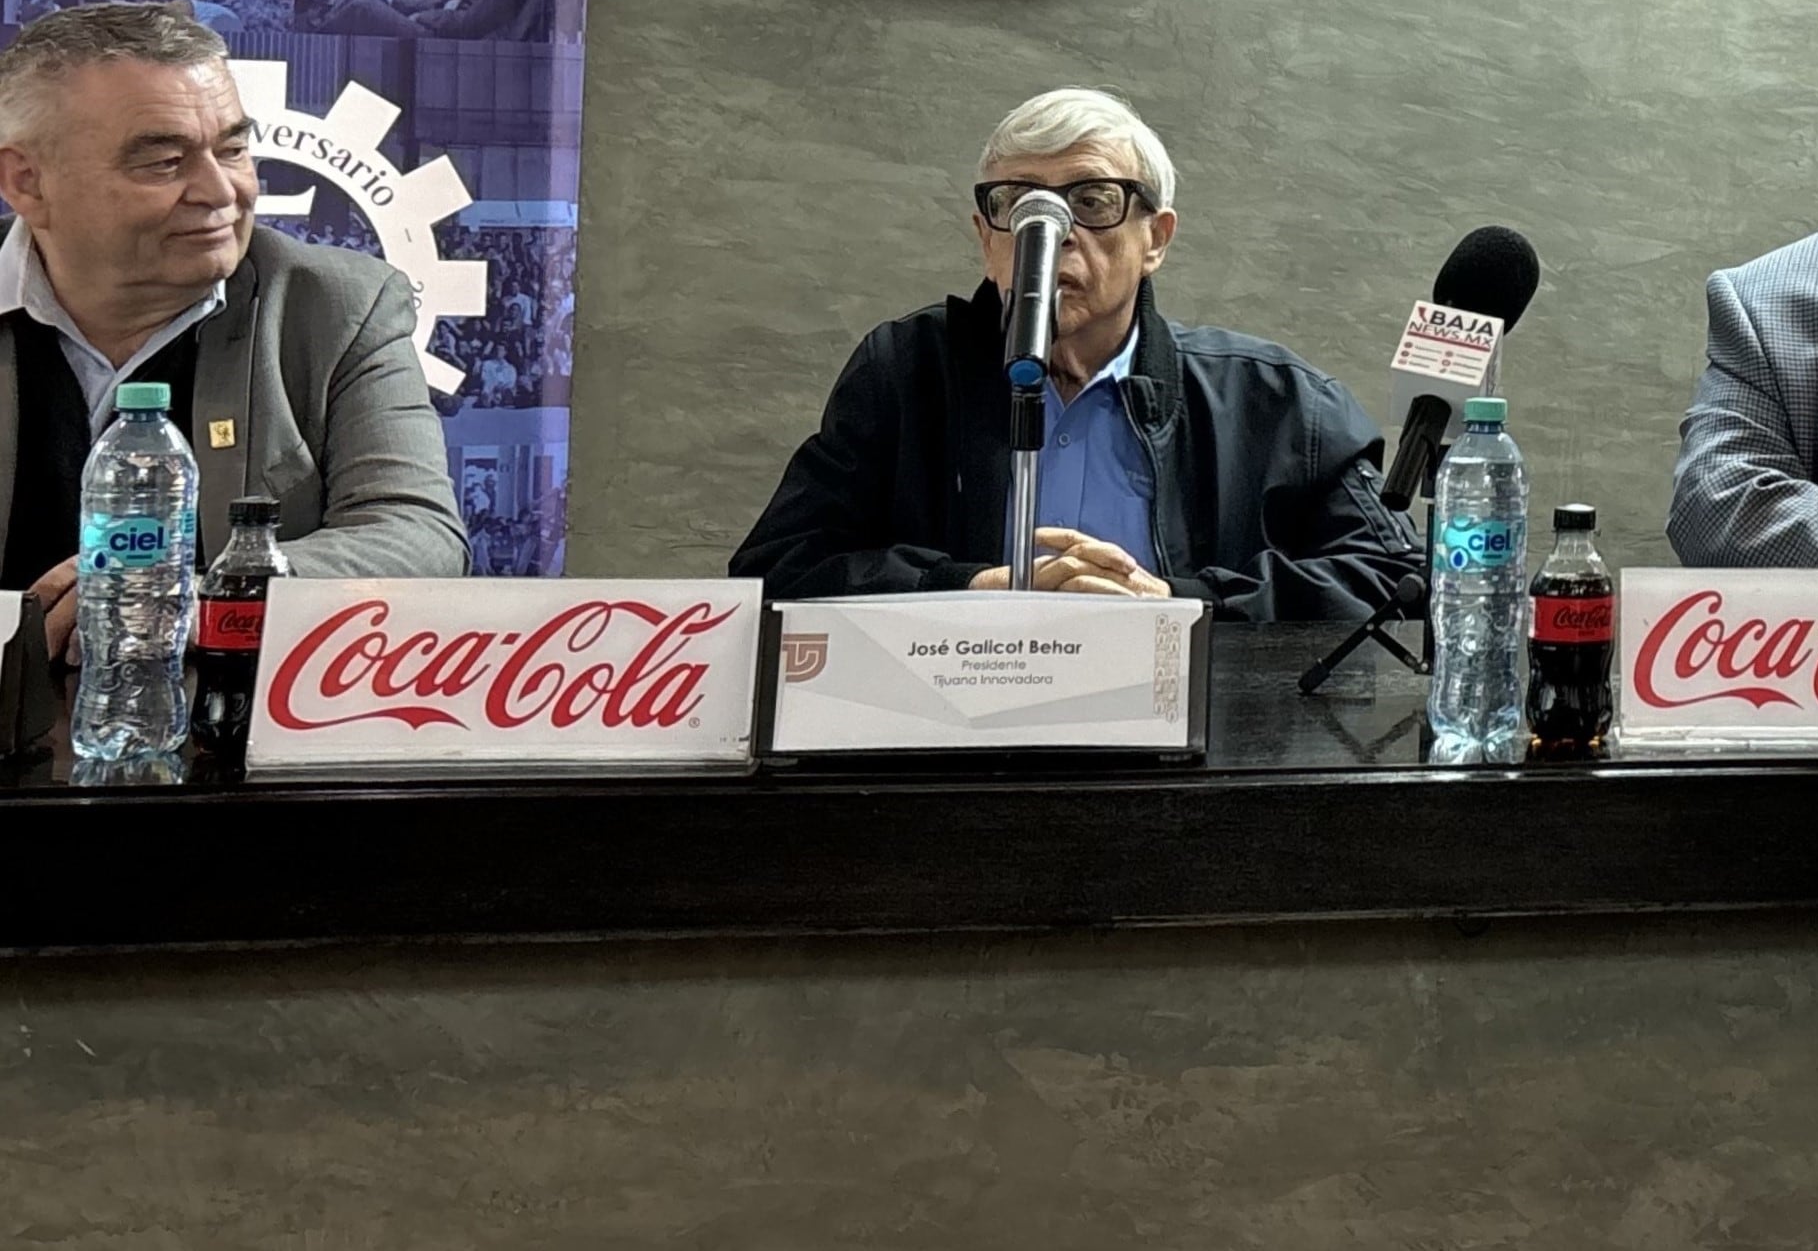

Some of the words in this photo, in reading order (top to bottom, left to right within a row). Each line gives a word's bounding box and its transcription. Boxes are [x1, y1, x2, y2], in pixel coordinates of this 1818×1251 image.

[1408, 320, 1495, 347] NEWS.MX
[1429, 309, 1494, 338] BAJA
[109, 526, 165, 552] ciel
[1468, 529, 1511, 552] ciel
[908, 639, 950, 656] José
[956, 639, 1024, 655] Galicot
[1029, 639, 1082, 655] Behar
[267, 600, 743, 731] Coca-Cola
[961, 660, 1027, 671] Presidente
[933, 674, 978, 688] Tijuana
[980, 673, 1054, 685] Innovadora
